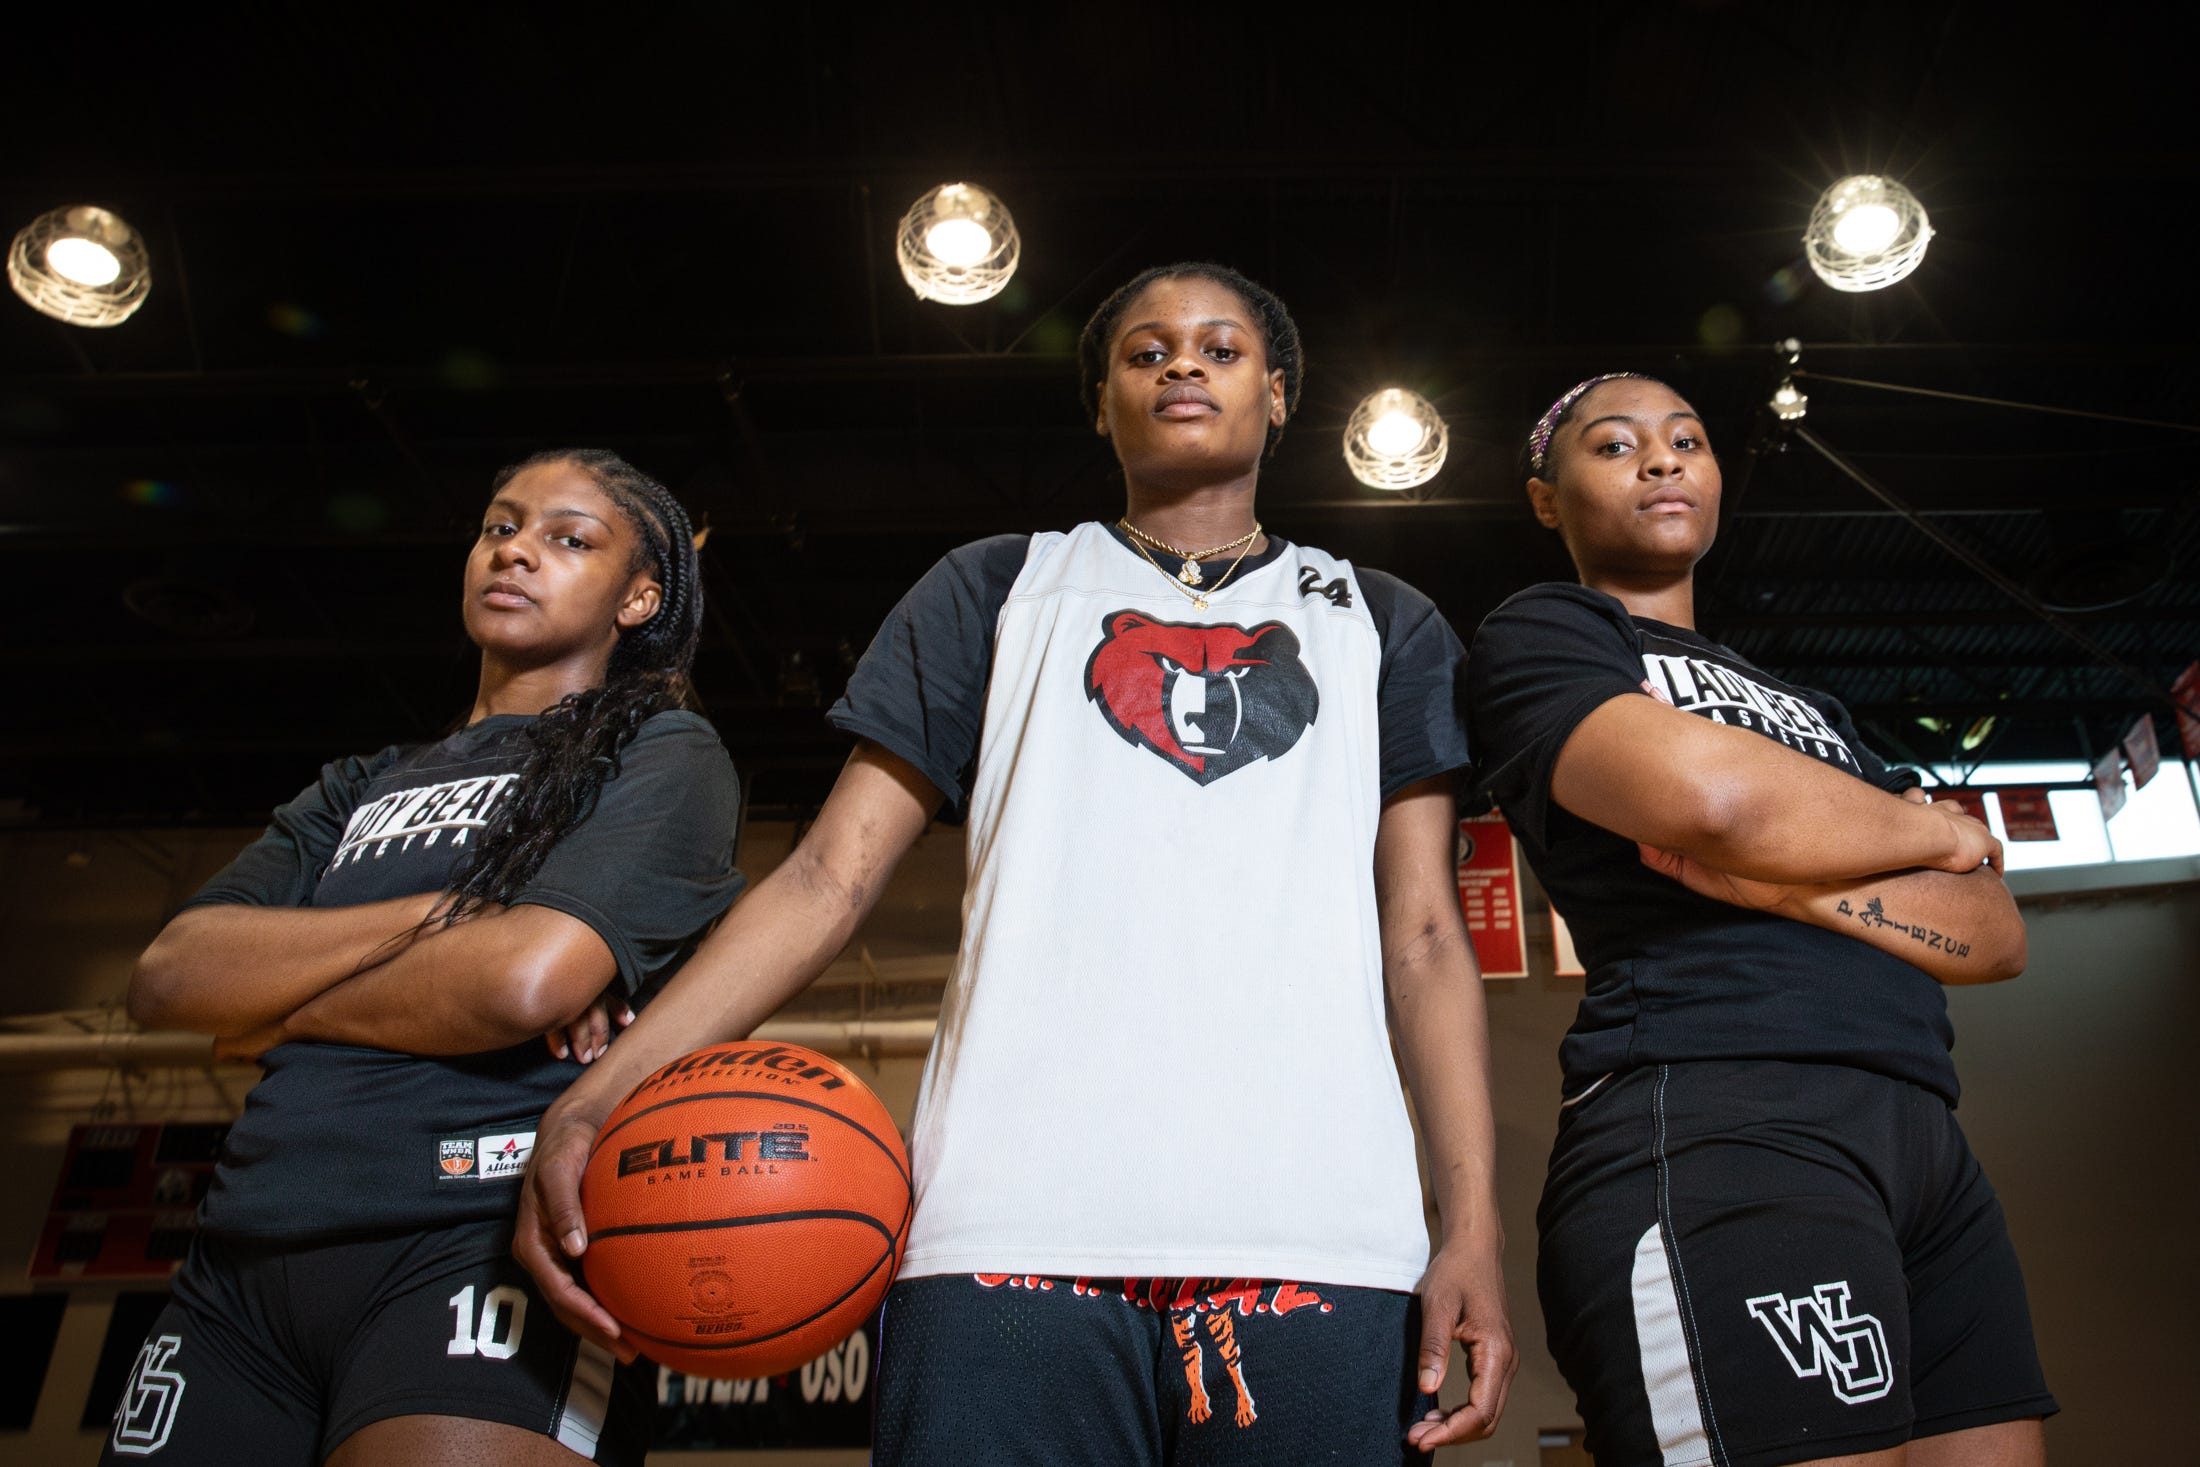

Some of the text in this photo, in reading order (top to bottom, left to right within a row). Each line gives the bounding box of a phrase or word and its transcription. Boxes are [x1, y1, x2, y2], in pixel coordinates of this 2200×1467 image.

[1299, 566, 1352, 608] 24
[1658, 659, 1765, 711] LADY
[1711, 708, 1849, 764] ASKETBA
[1837, 899, 1970, 958] PATIENCE
[441, 1142, 473, 1150] TEAM
[617, 1131, 809, 1179] ELITE
[647, 1165, 778, 1185] GAME BALL
[447, 1285, 528, 1360] 10
